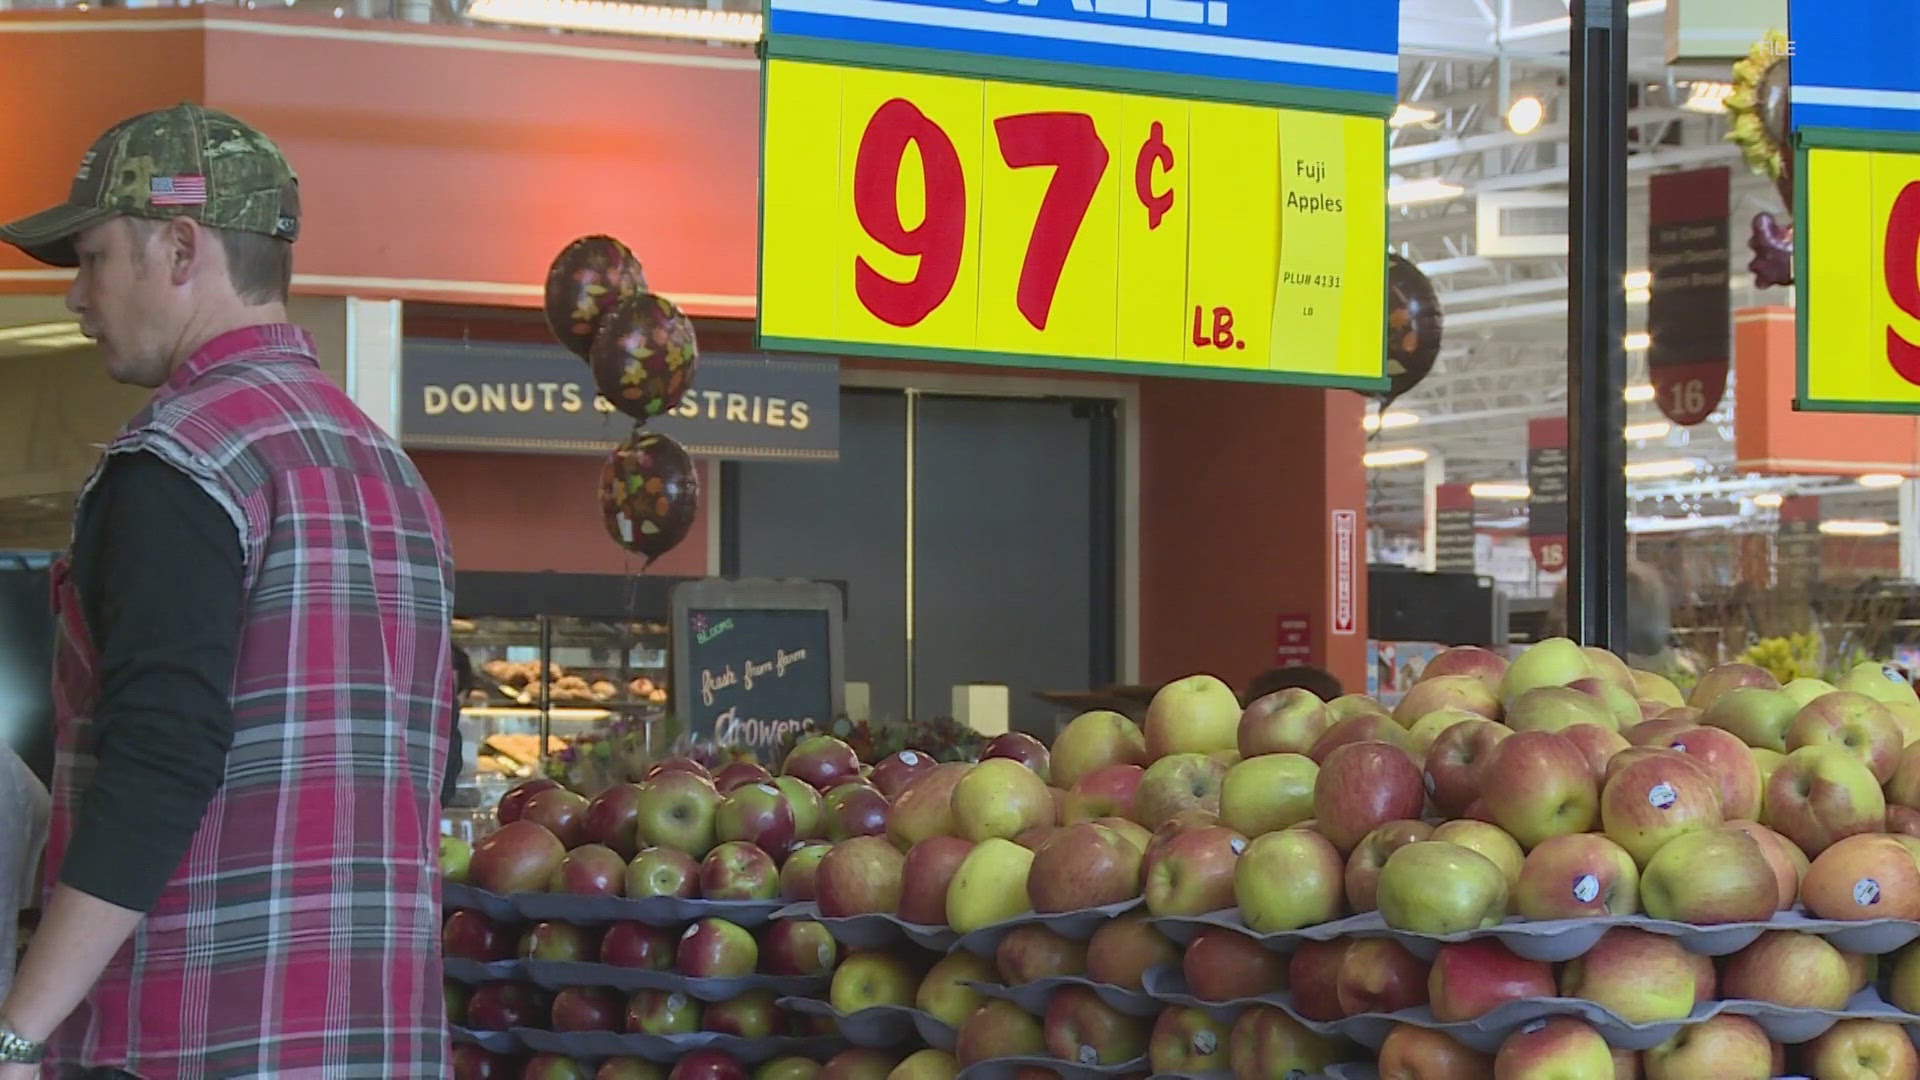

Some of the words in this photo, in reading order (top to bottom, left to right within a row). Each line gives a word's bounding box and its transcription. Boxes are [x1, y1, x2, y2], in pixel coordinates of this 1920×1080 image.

[1296, 159, 1326, 183] Fuji
[1286, 191, 1343, 214] Apples
[1283, 271, 1311, 286] PLU#
[1313, 275, 1341, 288] 4131
[1193, 305, 1245, 350] LB.
[423, 382, 582, 415] DONUTS
[668, 388, 809, 430] STRIES
[1671, 379, 1705, 415] 16
